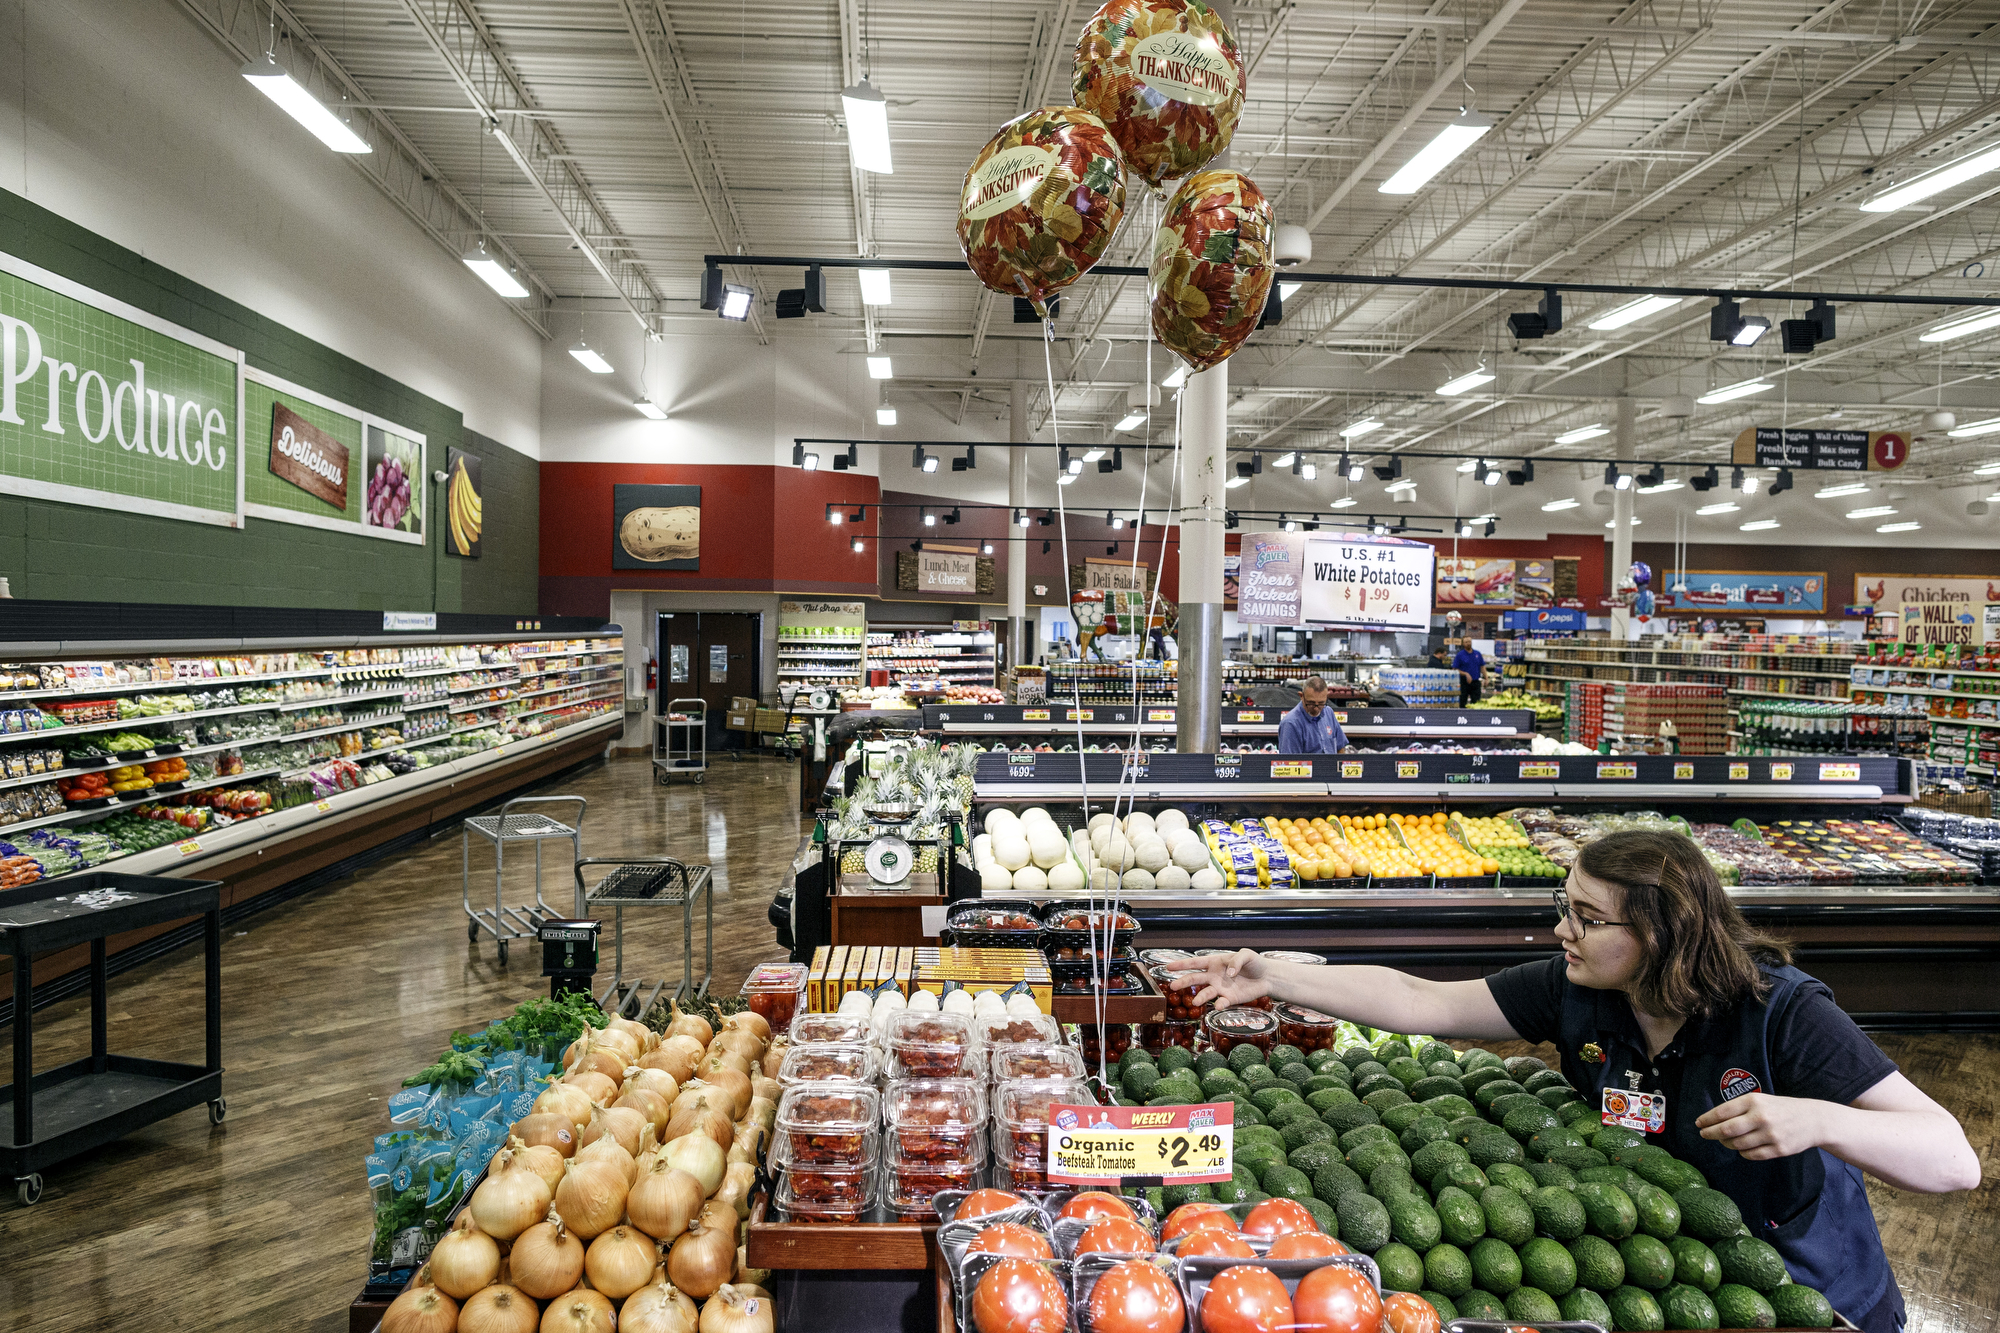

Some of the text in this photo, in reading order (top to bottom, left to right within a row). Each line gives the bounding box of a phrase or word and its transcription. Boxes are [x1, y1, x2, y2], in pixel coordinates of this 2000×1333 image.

[1164, 36, 1213, 70] Happy
[1138, 55, 1230, 97] THANKSGIVING
[982, 157, 1024, 184] Happy
[0, 313, 227, 470] Produce
[1757, 431, 1779, 440] Fresh
[278, 426, 343, 485] Delicious
[1757, 444, 1809, 453] Fresh Fruit
[1820, 446, 1860, 454] Max Saver
[1885, 441, 1896, 459] 1
[1818, 459, 1862, 469] Bulk Candy
[1341, 548, 1396, 563] U.S. #1
[924, 559, 970, 573] Lunch Meat
[928, 572, 967, 586] & Cheese
[1093, 572, 1111, 588] Deli
[1248, 571, 1295, 587] Fresh
[1314, 562, 1421, 587] White Potatoes
[1243, 585, 1298, 602] Picked
[803, 604, 841, 613] Nut Shop
[1242, 602, 1297, 618] SAVINGS
[1390, 603, 1409, 614] /EA
[1923, 605, 1955, 623] WALL
[1550, 614, 1573, 623] pepsi
[1906, 625, 1972, 644] OF VALUES!
[1019, 692, 1046, 700] HONEY
[1723, 1071, 1745, 1085] QUALITY
[1723, 1077, 1757, 1100] KARNS
[1131, 1112, 1176, 1125] WEEKLY
[1190, 1109, 1214, 1119] MAX
[1625, 1120, 1645, 1128] HELEN
[1060, 1136, 1135, 1154] Organic
[1057, 1152, 1136, 1170] Beefsteak Tomatoes
[1208, 1157, 1225, 1167] /LB
